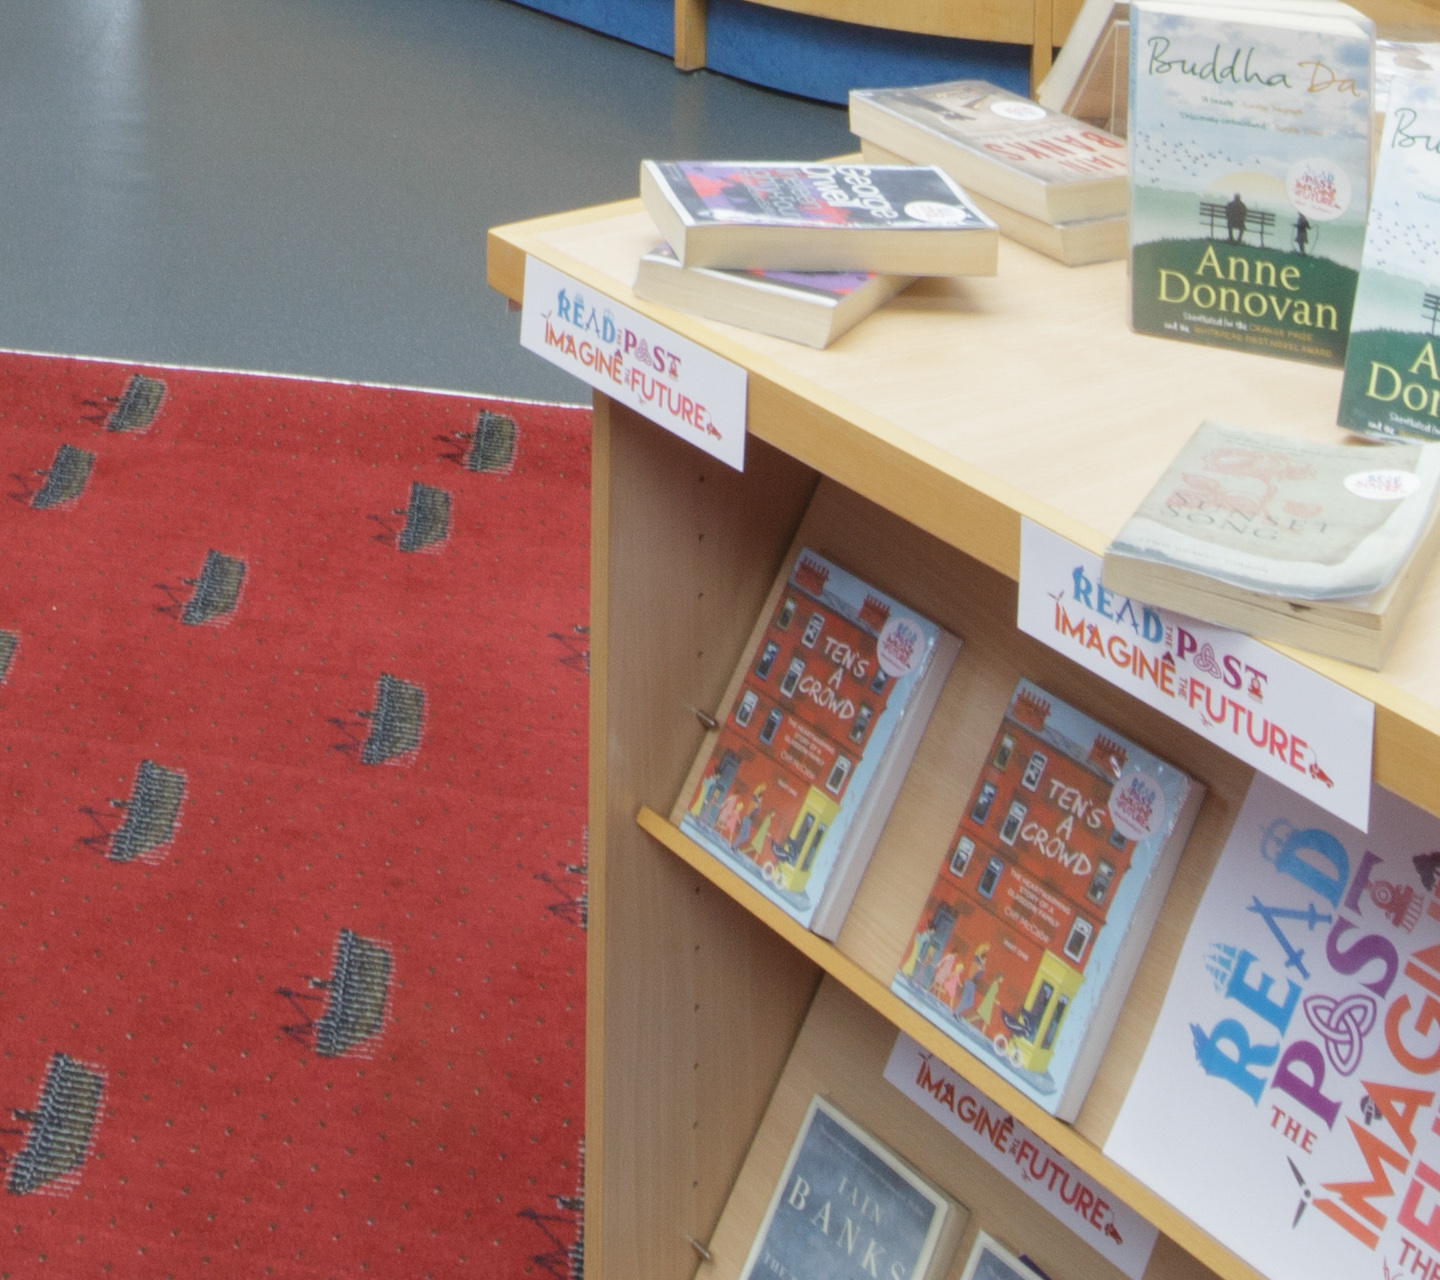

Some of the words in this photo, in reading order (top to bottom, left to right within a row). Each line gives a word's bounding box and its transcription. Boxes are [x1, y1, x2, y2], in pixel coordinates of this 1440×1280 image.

[1148, 36, 1292, 91] Buddha
[1299, 60, 1360, 98] Da
[1195, 246, 1301, 293] Anne
[557, 288, 617, 344] READ
[1158, 269, 1339, 331] Donovan
[543, 312, 623, 387] IMAGINE
[629, 371, 707, 433] FUTURE
[1190, 827, 1351, 1108] READ
[1268, 1105, 1318, 1153] THE
[838, 1176, 882, 1225] IAIN
